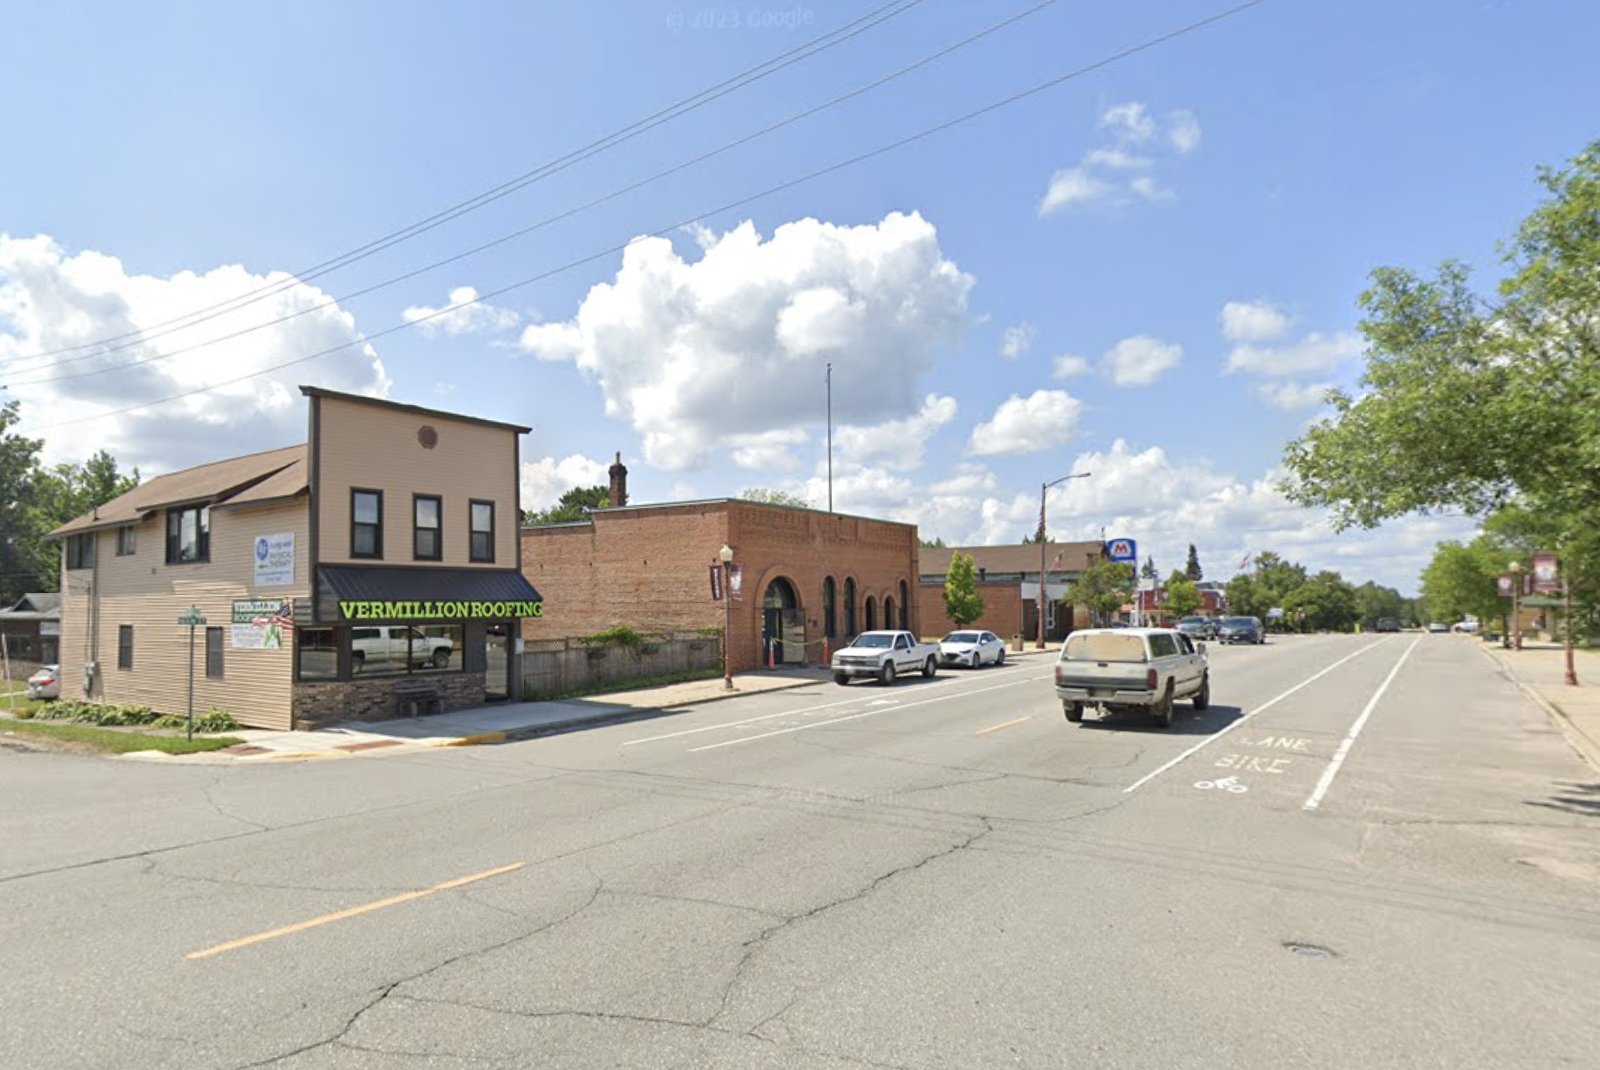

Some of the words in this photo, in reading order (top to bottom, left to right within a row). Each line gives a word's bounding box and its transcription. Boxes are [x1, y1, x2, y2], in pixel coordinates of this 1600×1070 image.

[340, 601, 468, 619] VERMILLION
[470, 601, 544, 617] ROOFING
[1240, 735, 1314, 751] LANE
[1214, 753, 1292, 774] BIKE
